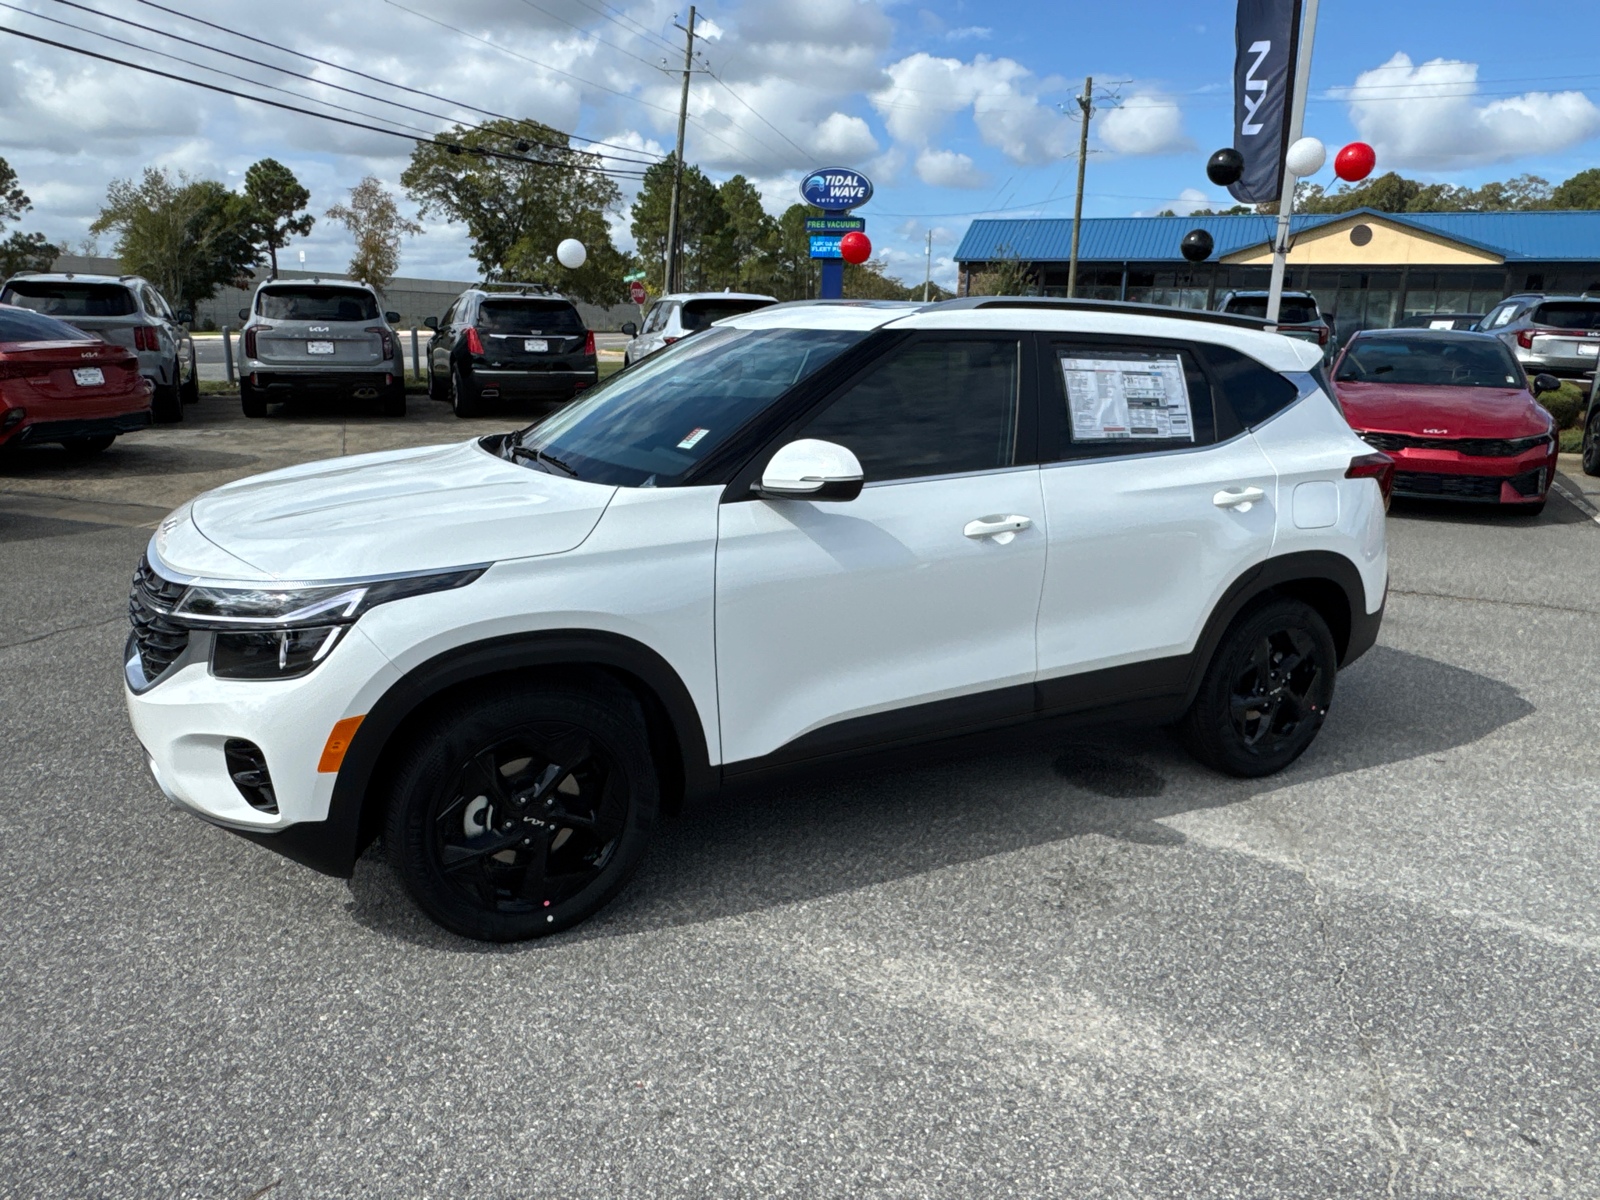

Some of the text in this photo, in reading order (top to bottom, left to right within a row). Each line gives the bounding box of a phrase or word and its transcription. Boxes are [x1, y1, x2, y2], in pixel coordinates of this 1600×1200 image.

[825, 175, 858, 186] TIDAL
[830, 186, 865, 198] WAVE
[826, 220, 861, 229] VACUUMS
